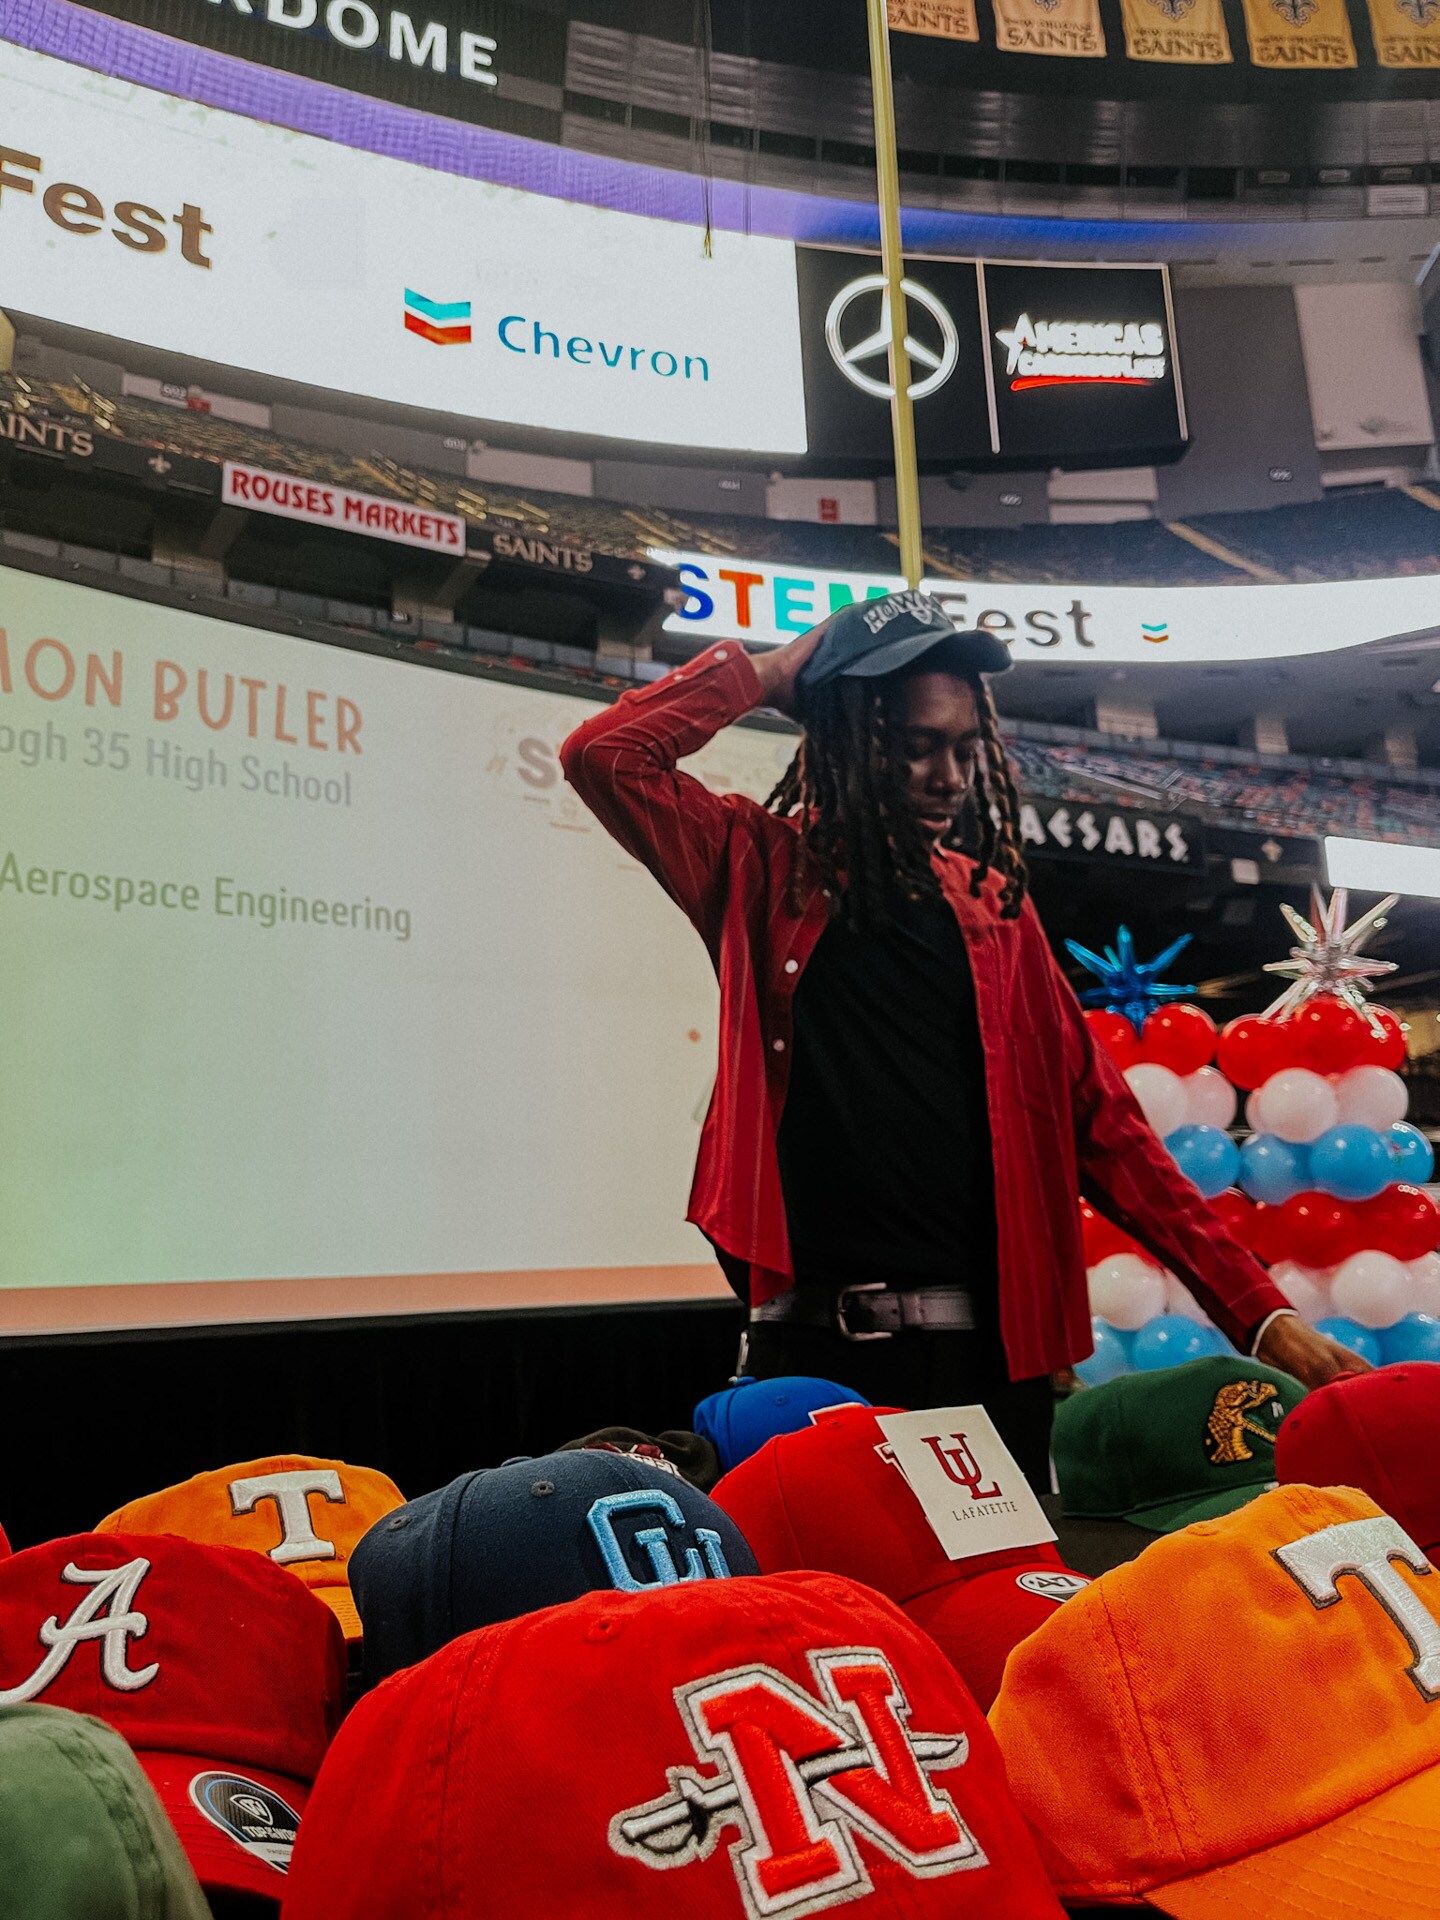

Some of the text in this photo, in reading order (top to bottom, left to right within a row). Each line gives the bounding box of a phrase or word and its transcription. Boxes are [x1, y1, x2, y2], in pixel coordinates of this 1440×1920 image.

[208, 0, 498, 87] DOME
[1008, 28, 1098, 51] SAINTS
[1133, 37, 1224, 60] SAINTS
[1257, 43, 1349, 64] SAINTS
[0, 146, 213, 270] Fest
[498, 315, 710, 382] Chevron
[231, 470, 459, 546] ROUSES MARKETS
[493, 532, 593, 572] SAINTS
[153, 660, 363, 756] BUTLER
[83, 727, 130, 771] 35
[146, 737, 228, 792] High
[241, 755, 352, 806] School
[0, 851, 412, 942] Aerospace Engineering
[230, 1469, 347, 1565] T
[951, 1500, 1019, 1522] LAFAYETTE
[0, 1557, 160, 1704] A
[1269, 1515, 1440, 1704] T
